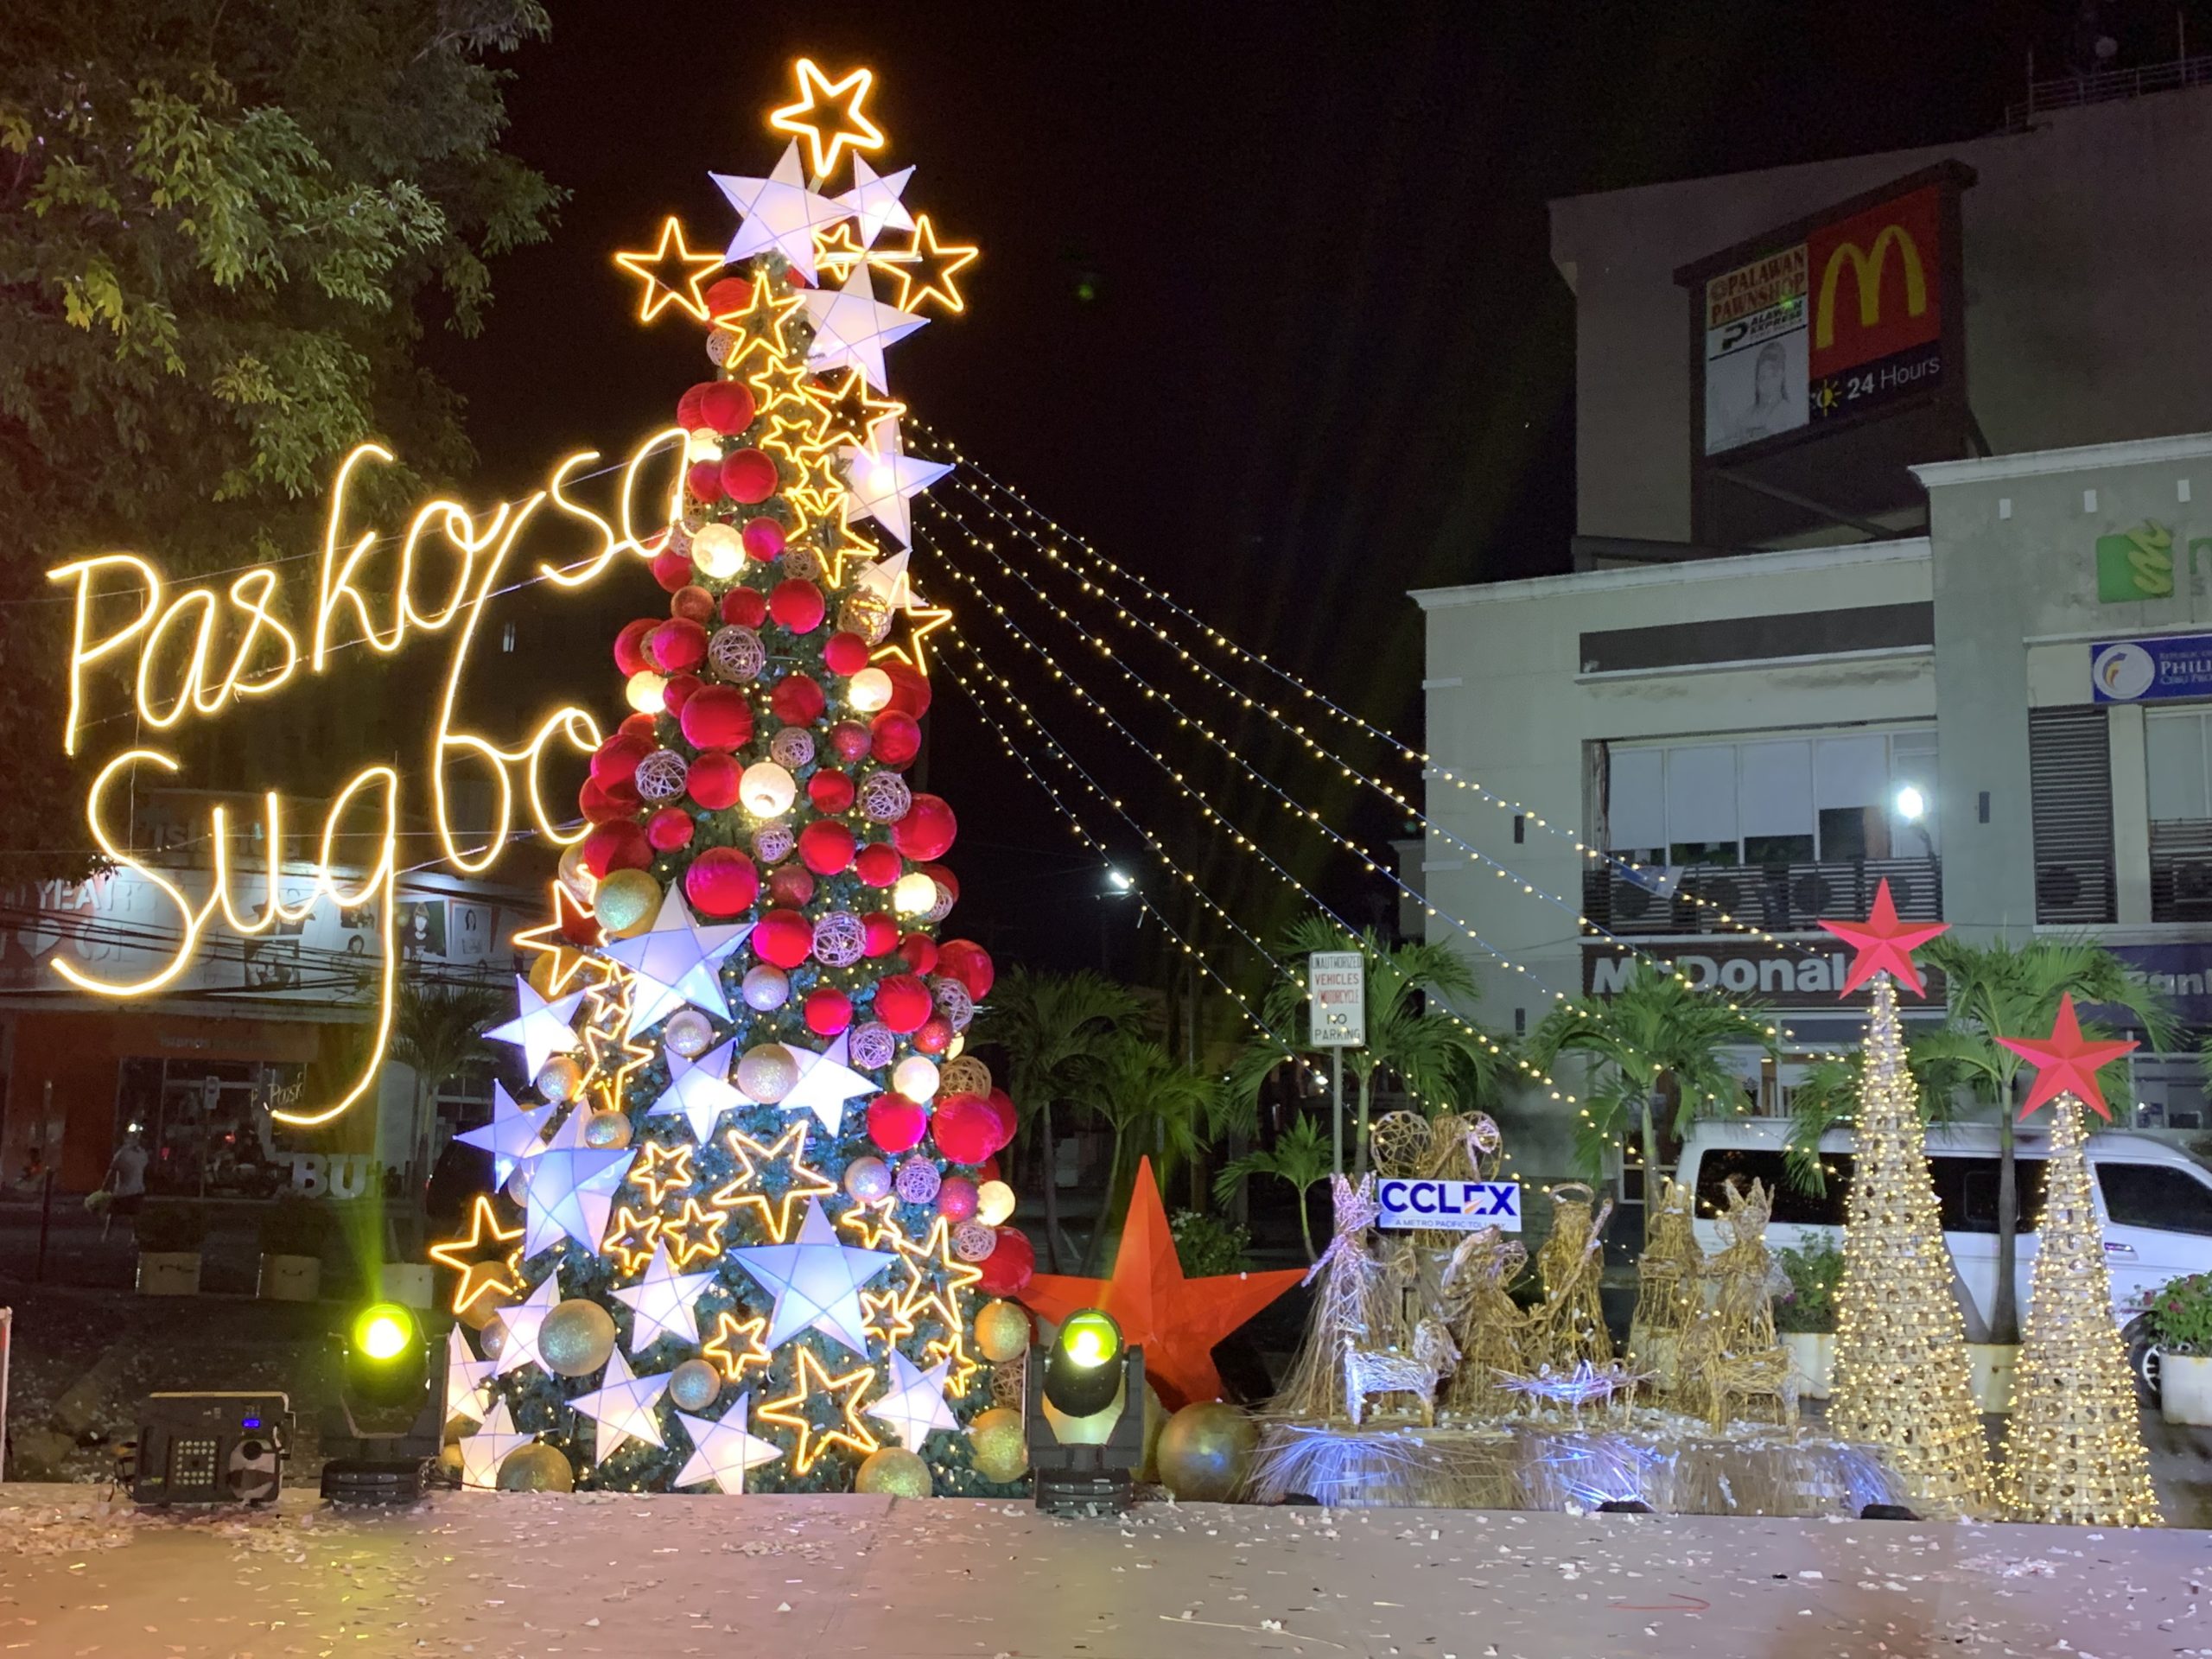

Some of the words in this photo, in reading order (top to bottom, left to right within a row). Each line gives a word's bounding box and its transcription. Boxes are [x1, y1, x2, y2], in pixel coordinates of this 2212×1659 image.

[1728, 251, 1805, 296] PALAWAN
[1712, 271, 1805, 325] PAWNSHOP
[1847, 372, 1874, 400] 24
[1880, 357, 1941, 390] Hours
[50, 489, 603, 1124] Sugbo
[1312, 956, 1362, 969] UNAUTHORIZED
[1314, 973, 1359, 985] VEHICLES
[1592, 953, 1928, 993] MDonal
[1314, 1027, 1361, 1040] PARKING
[1326, 1013, 1347, 1025] NO
[1382, 1181, 1517, 1216] CCLEX
[1435, 1219, 1466, 1228] PACIFIC
[1468, 1220, 1506, 1230] TOLAY
